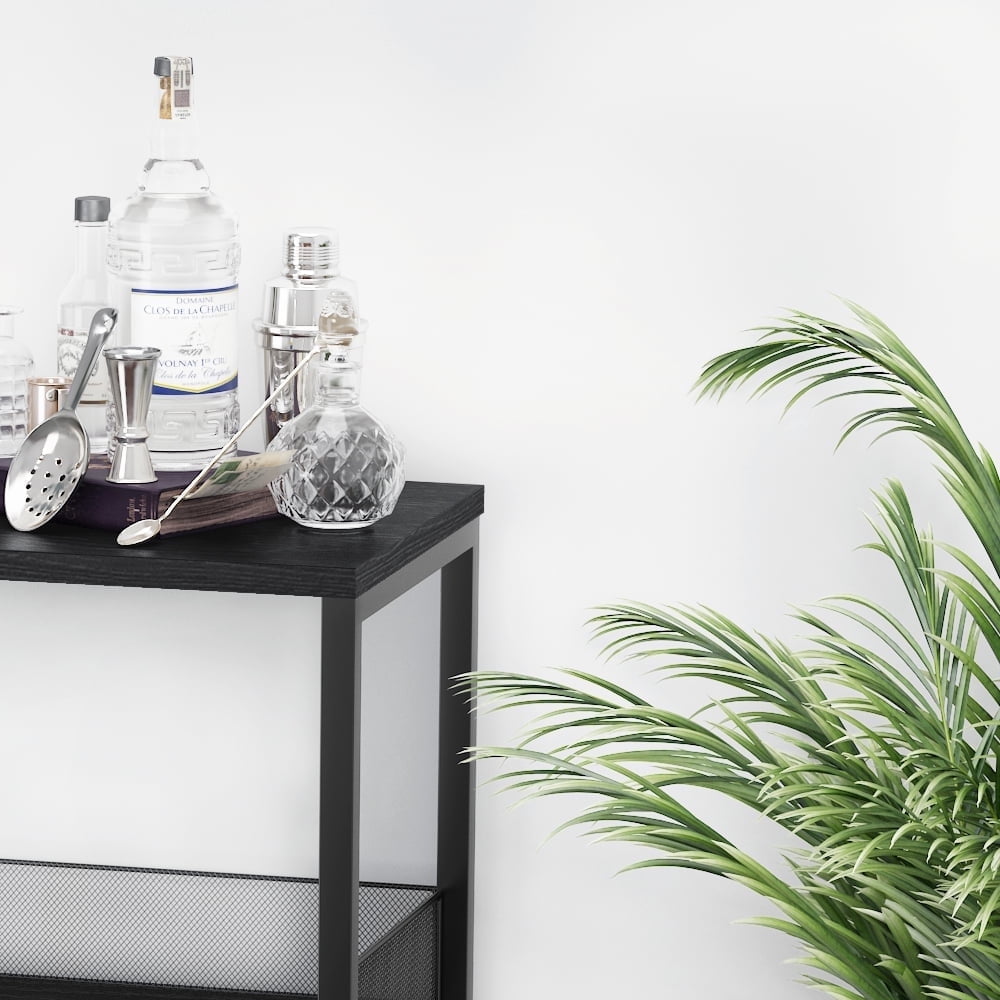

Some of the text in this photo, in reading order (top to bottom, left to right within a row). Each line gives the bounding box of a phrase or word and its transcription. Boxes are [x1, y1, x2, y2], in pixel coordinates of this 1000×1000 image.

[176, 297, 213, 305] DOMAINE
[143, 305, 171, 315] CLOS
[158, 359, 198, 367] VOLNAY
